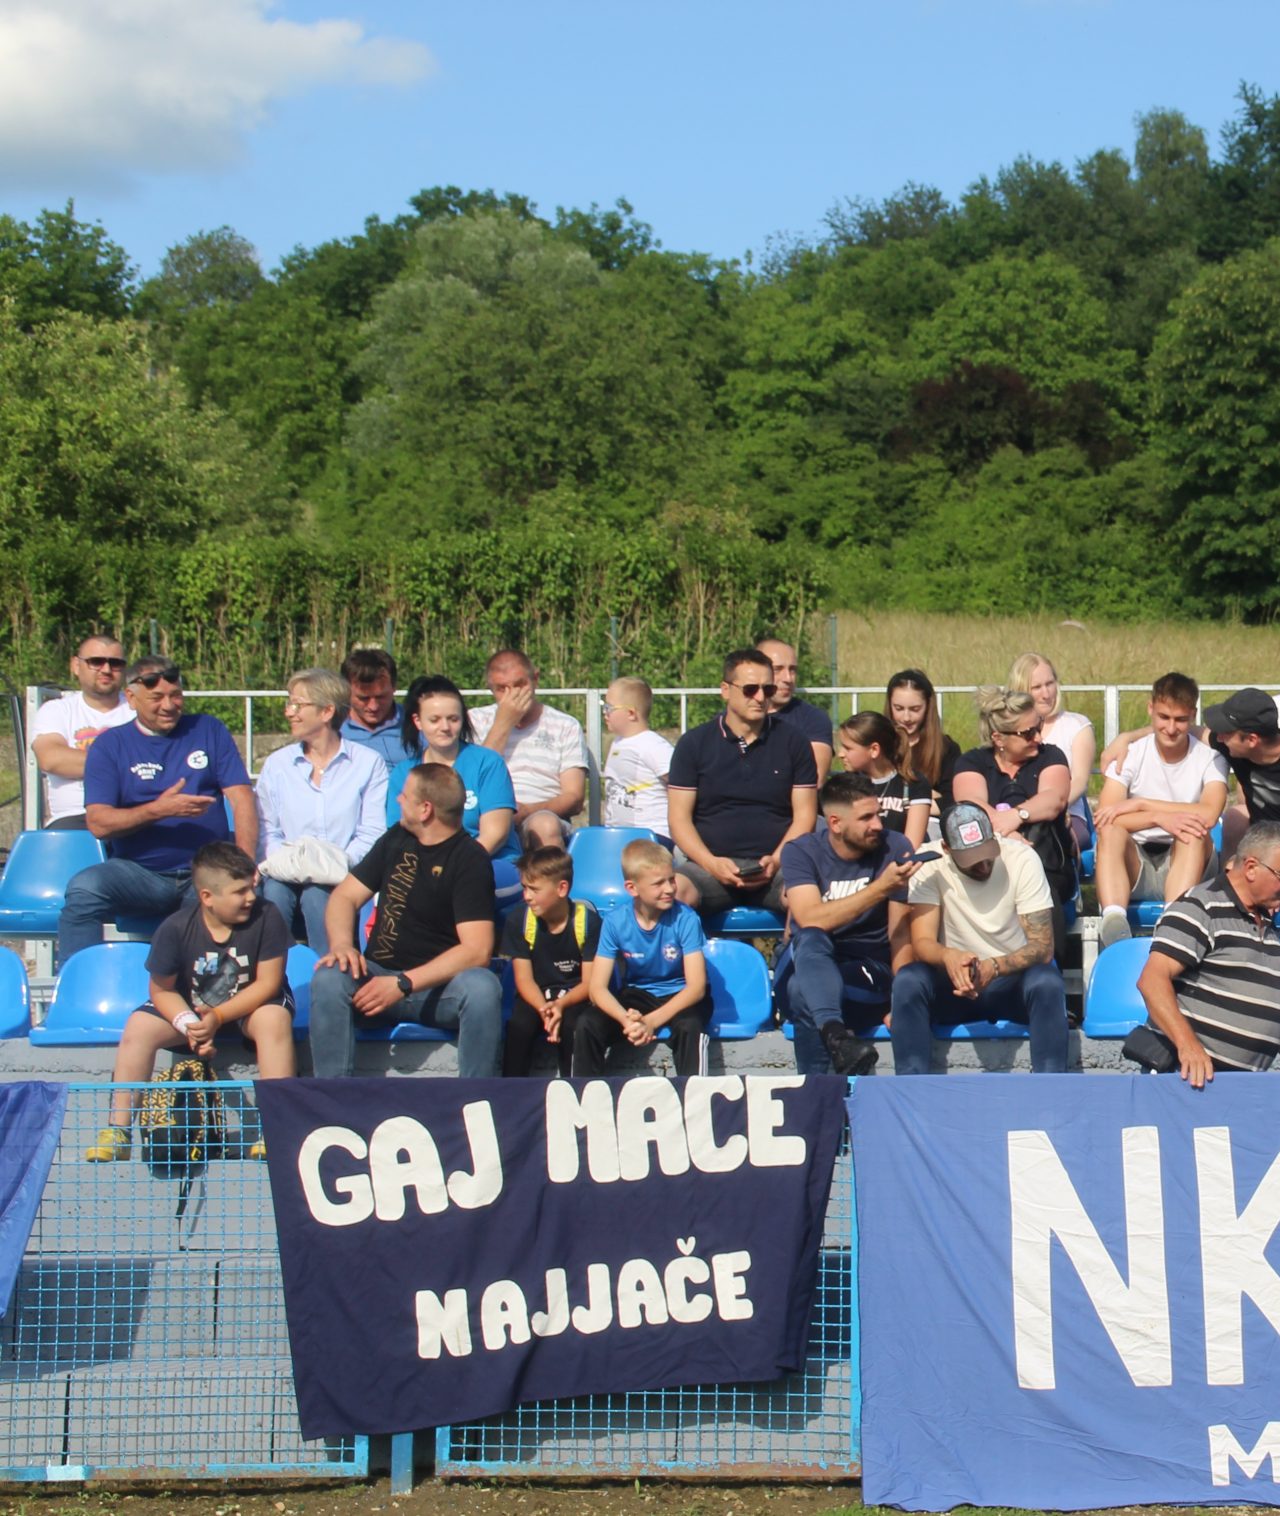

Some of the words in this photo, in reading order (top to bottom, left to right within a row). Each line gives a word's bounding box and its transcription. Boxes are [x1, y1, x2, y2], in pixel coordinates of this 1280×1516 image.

[828, 876, 870, 901] NIKE
[298, 1100, 503, 1227] GAJ
[416, 1237, 754, 1359] NAJJAČE
